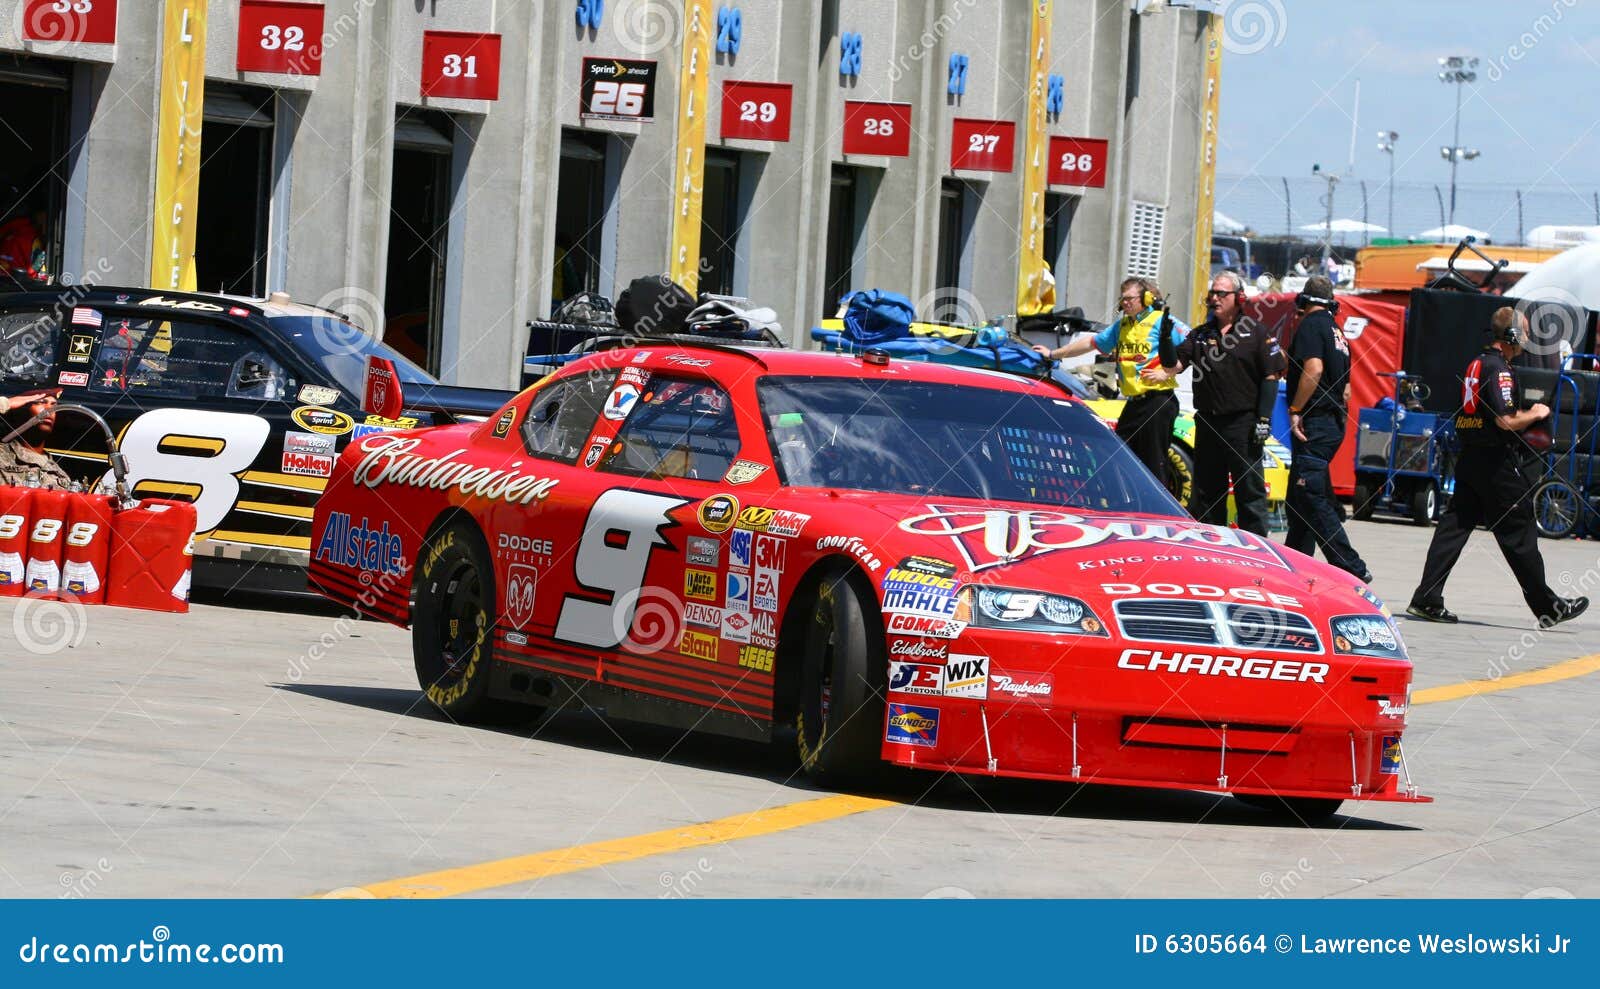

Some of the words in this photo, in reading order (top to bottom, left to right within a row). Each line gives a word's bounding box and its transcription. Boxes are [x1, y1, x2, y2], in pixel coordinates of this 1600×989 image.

[260, 25, 305, 52] 32
[716, 6, 743, 56] 29
[840, 32, 863, 76] 28
[442, 54, 478, 79] 31
[591, 64, 616, 74] Sprint
[947, 52, 969, 96] 27
[589, 81, 647, 115] 26
[740, 101, 777, 122] 29
[863, 118, 894, 137] 28
[968, 134, 1000, 153] 27
[1061, 152, 1093, 171] 26
[1343, 316, 1371, 340] 9
[311, 416, 333, 425] Sprint
[92, 408, 271, 535] 8
[284, 452, 331, 475] Holley
[353, 435, 560, 505] Budweiser
[0, 515, 25, 539] 8
[31, 519, 62, 543] 8
[67, 522, 99, 547] 8
[898, 509, 1262, 559] Bud
[316, 511, 403, 577] Allstate
[423, 530, 455, 579] EAGLE
[498, 533, 553, 556] DODGE
[756, 537, 785, 572] 3M
[816, 535, 882, 572] GOODYEAR
[496, 550, 552, 567] DEALERS
[553, 488, 690, 649] 9
[1077, 554, 1144, 571] KING
[1192, 555, 1266, 570] BEERS
[692, 584, 714, 595] Meter
[694, 573, 711, 584] Auto
[755, 574, 776, 598] EA
[886, 568, 958, 590] MOOG
[754, 595, 777, 611] SPORTS
[884, 589, 959, 615] MAHLE
[1000, 594, 1048, 619] 9
[1100, 582, 1304, 608] DODGE
[685, 604, 720, 625] DENSO
[751, 612, 776, 638] MAC
[891, 615, 947, 632] COMP
[751, 635, 776, 649] TOOLS
[925, 629, 952, 637] CAMS
[681, 631, 718, 660] Stant
[890, 639, 947, 659] Edelbrock
[738, 645, 775, 673] JEGS
[946, 659, 985, 682] WIX
[1117, 648, 1330, 684] CHARGER
[890, 664, 941, 690] JE
[945, 683, 985, 695] FILTERS
[904, 686, 942, 695] PISTONS
[891, 715, 937, 729] SUNOCO
